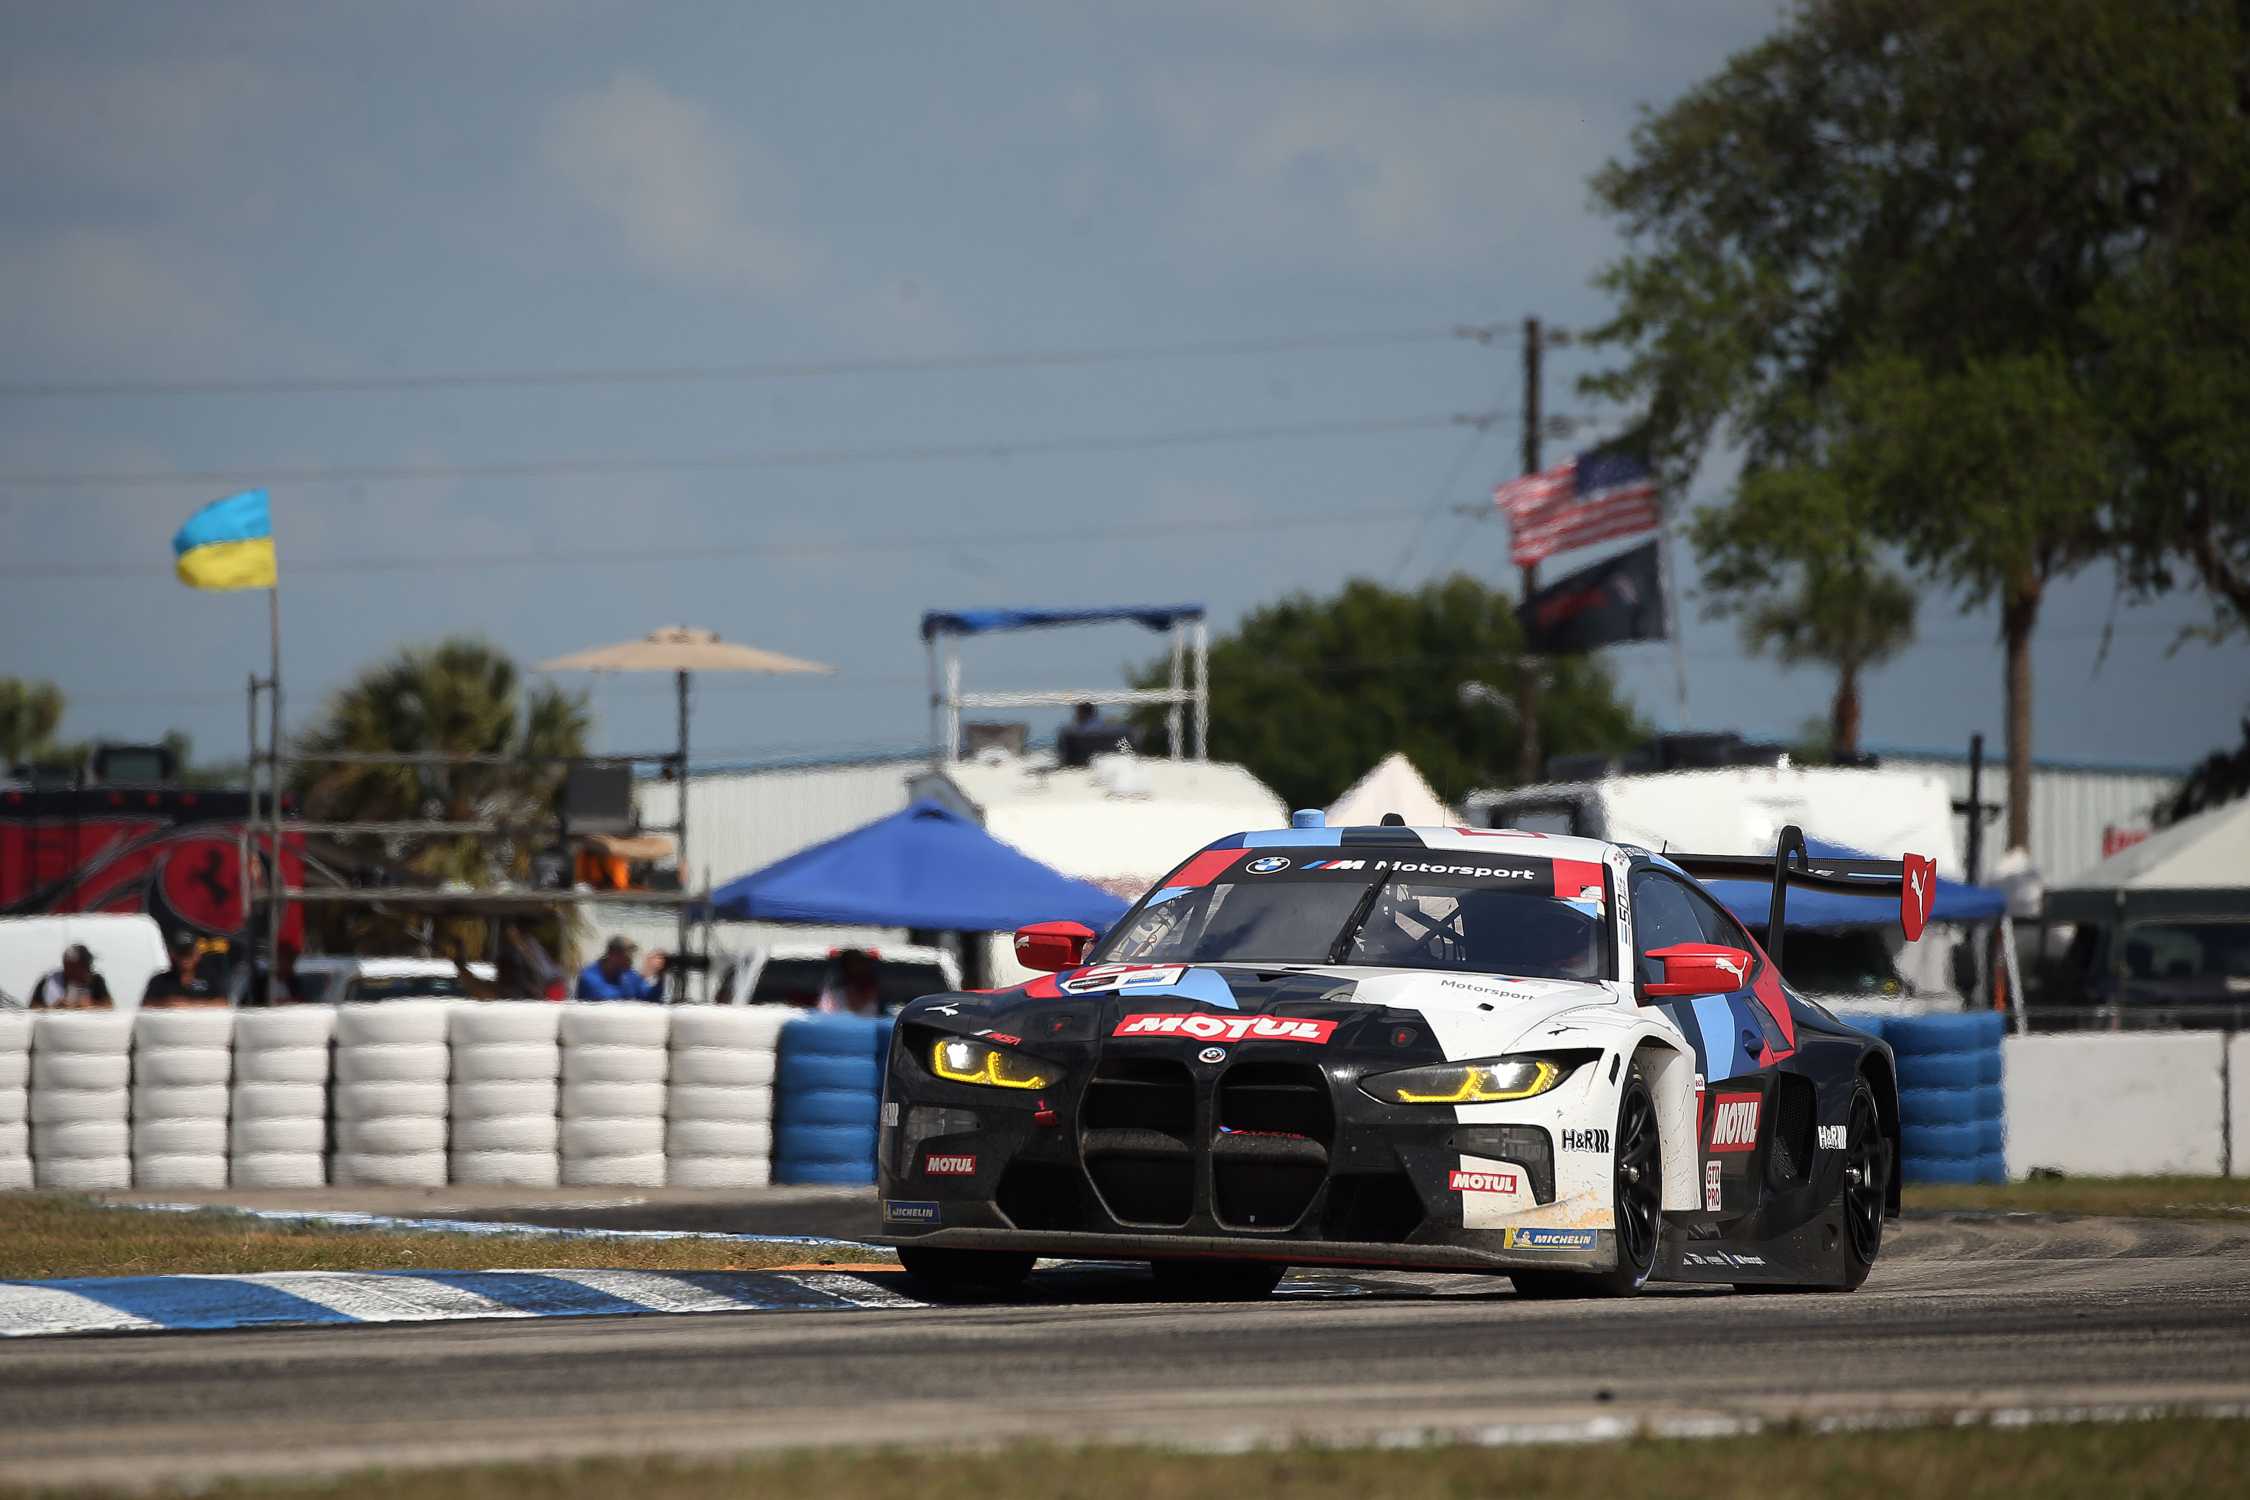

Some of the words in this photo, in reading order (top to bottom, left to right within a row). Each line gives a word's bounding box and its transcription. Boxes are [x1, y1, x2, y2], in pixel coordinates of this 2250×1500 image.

[1375, 861, 1536, 880] Motorsport
[1440, 979, 1536, 1000] Motorsport
[1124, 1016, 1321, 1038] MOTUL
[1712, 1102, 1759, 1144] MOTUL
[928, 1157, 973, 1172] MOTUL
[1452, 1173, 1514, 1192] MOTUL
[1707, 1188, 1720, 1206] PRO
[1533, 1234, 1592, 1245] MICHELIN
